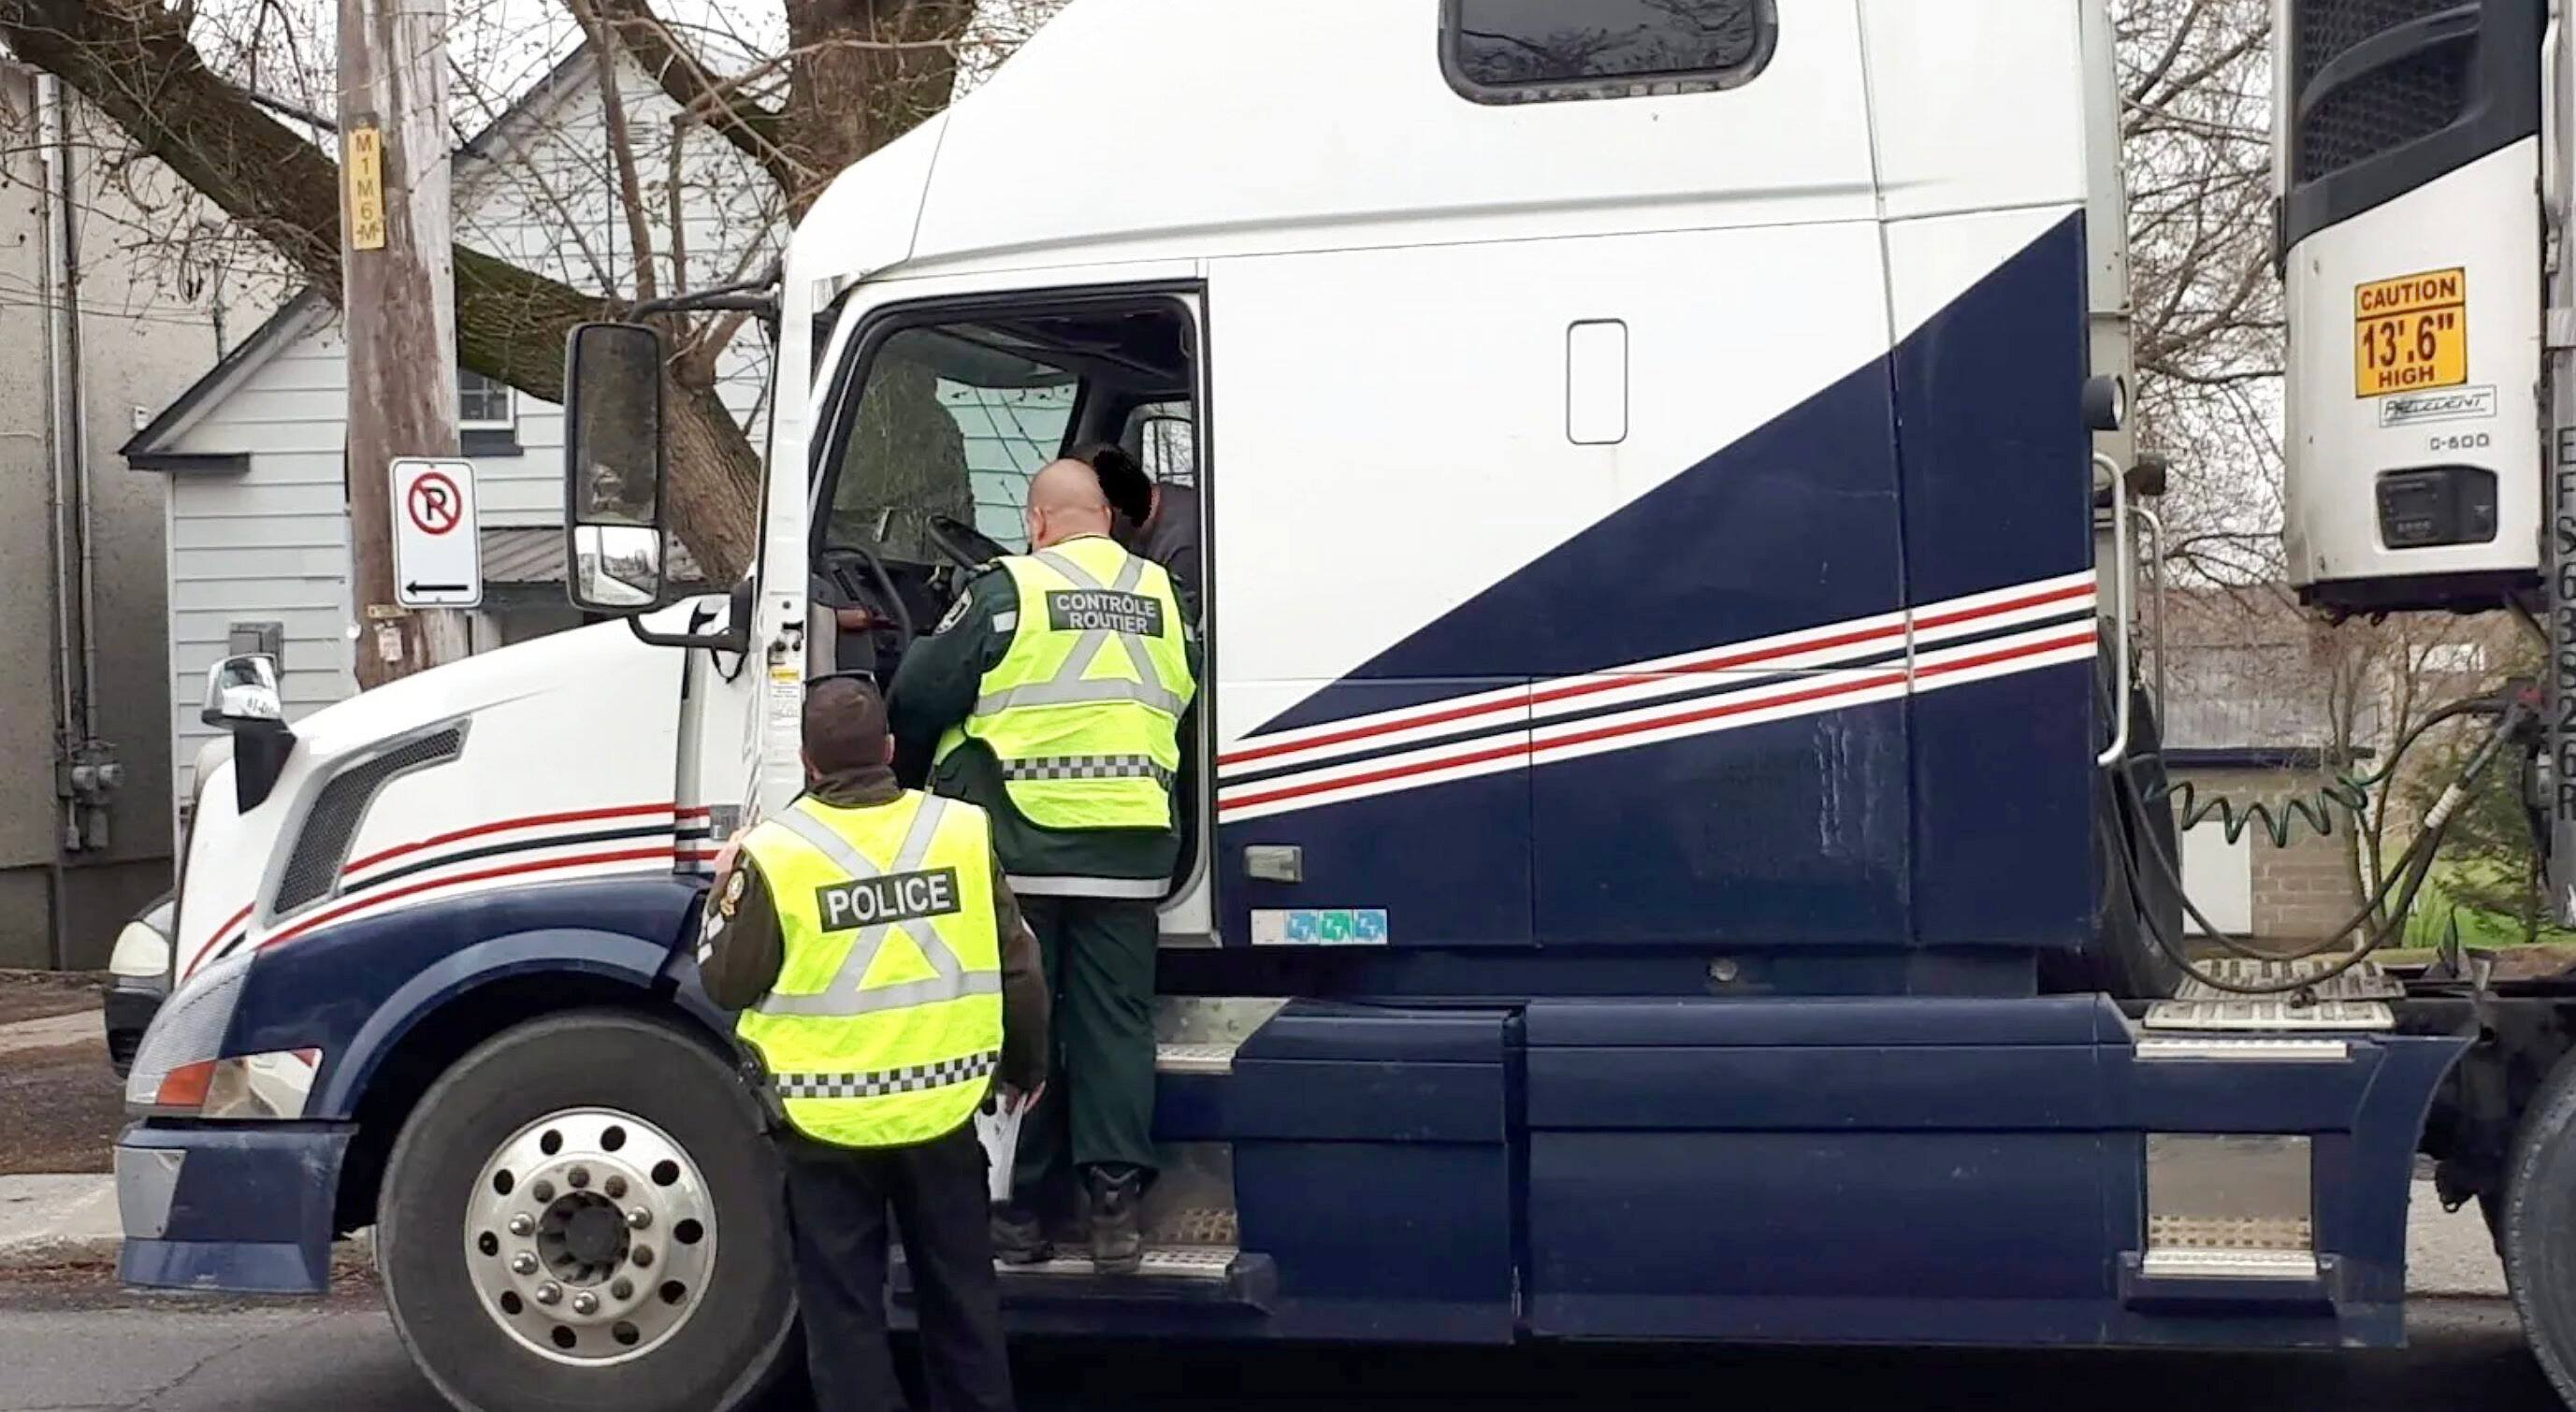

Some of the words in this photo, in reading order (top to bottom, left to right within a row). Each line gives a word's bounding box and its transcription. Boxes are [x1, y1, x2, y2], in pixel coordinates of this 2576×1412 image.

[2360, 277, 2457, 310] CAUTION
[2379, 365, 2435, 388] HIGH
[1056, 593, 1157, 617] CONTRÔLE
[1069, 612, 1149, 633] ROUTIER
[826, 874, 951, 925] POLICE
